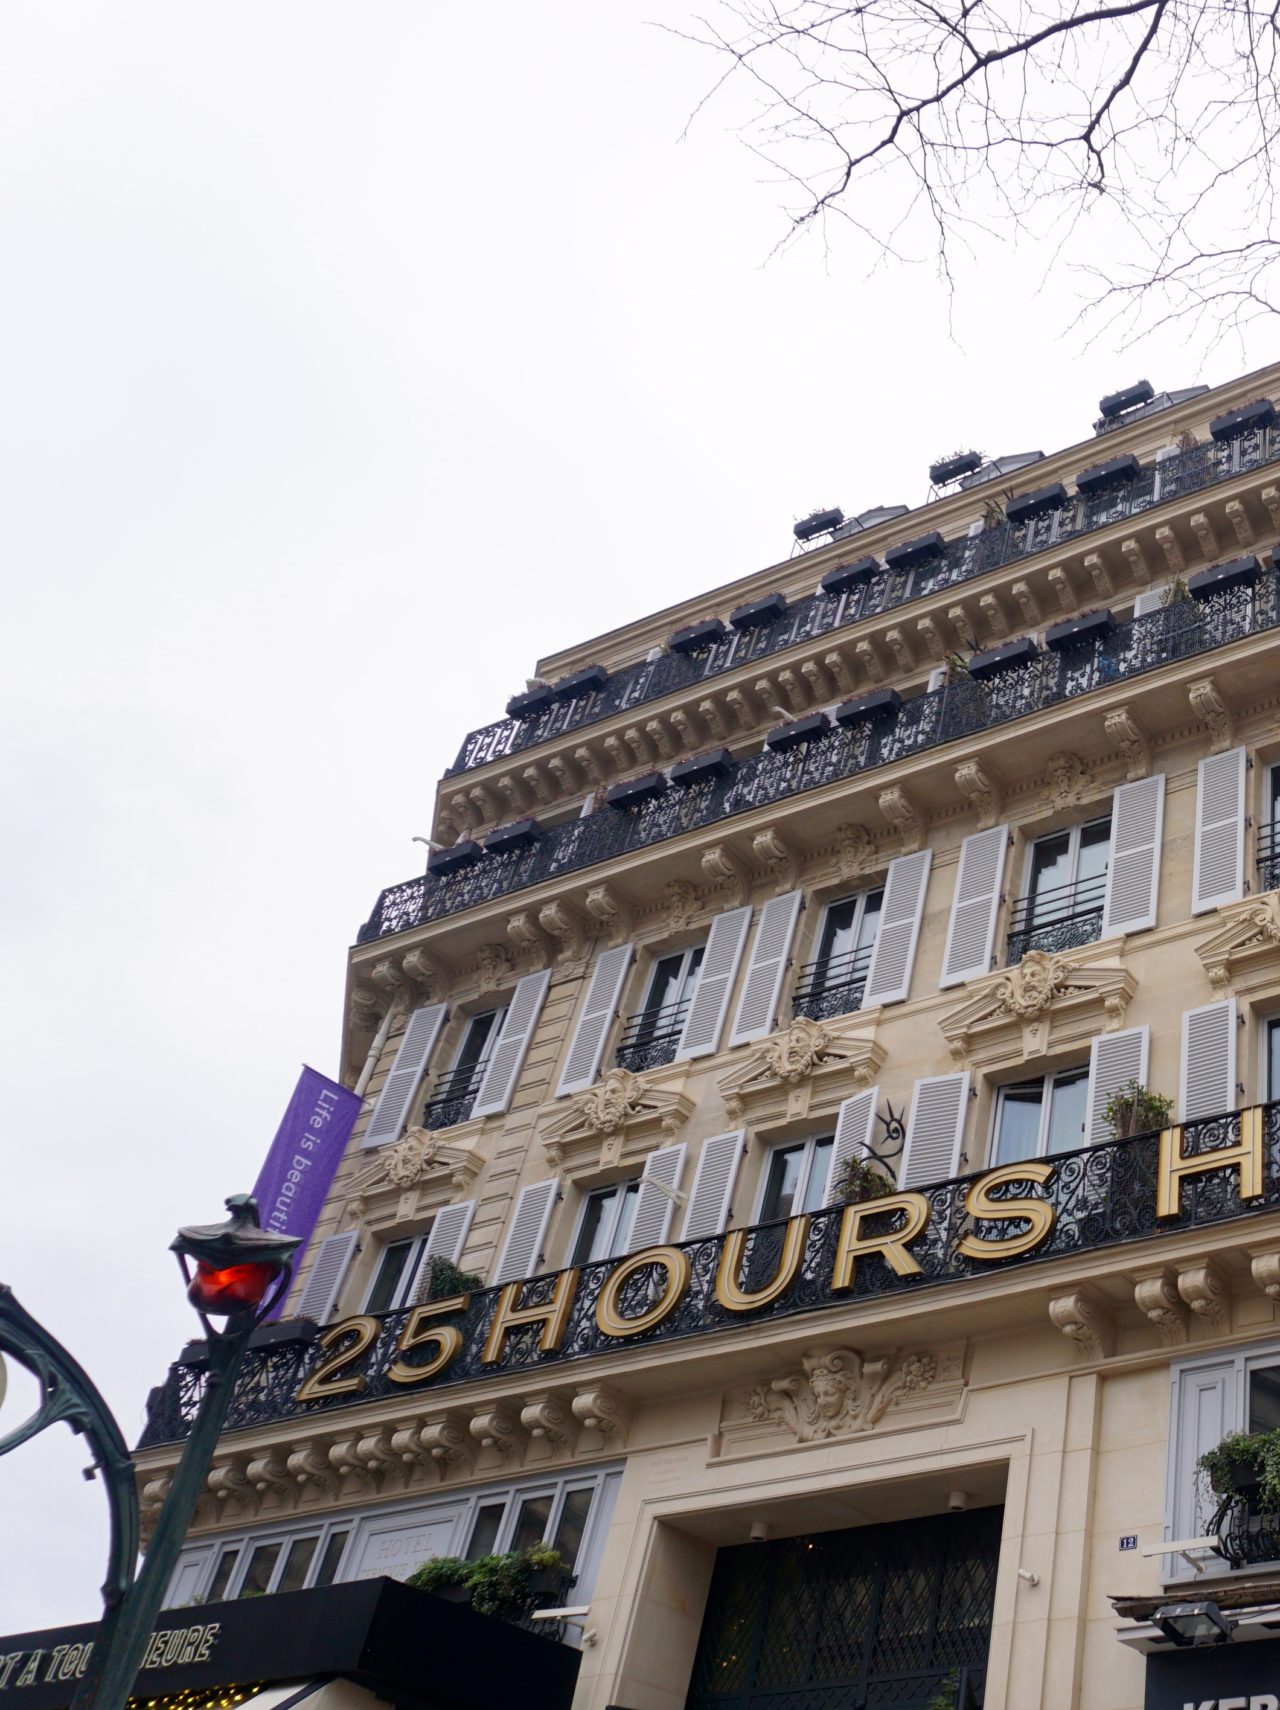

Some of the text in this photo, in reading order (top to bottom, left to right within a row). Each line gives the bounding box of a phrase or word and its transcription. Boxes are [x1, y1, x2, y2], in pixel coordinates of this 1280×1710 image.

[310, 1089, 339, 1128] Life
[300, 1132, 321, 1151] is
[0, 1651, 21, 1690] T
